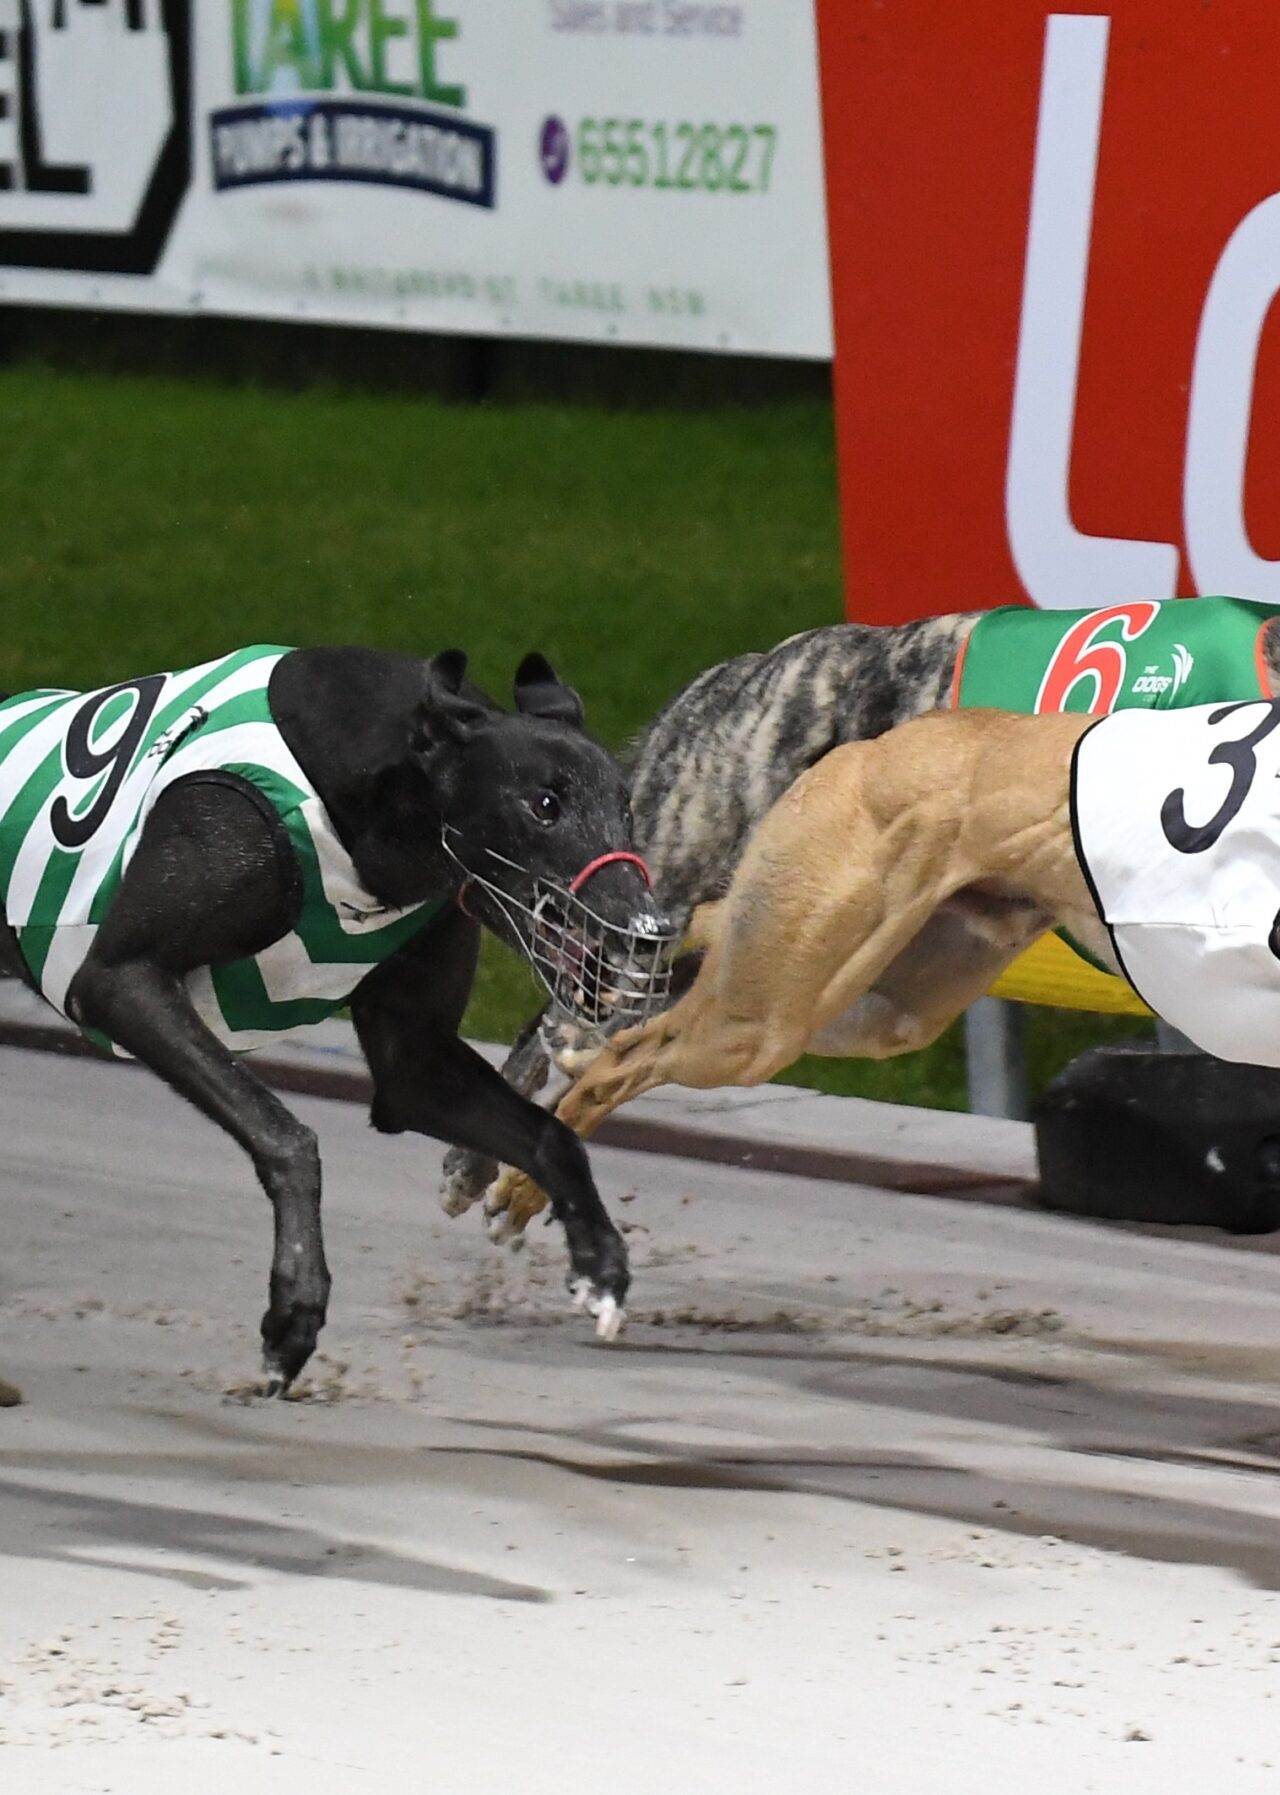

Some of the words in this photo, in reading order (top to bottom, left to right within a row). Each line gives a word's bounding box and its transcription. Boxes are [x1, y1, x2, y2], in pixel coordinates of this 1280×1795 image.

[217, 112, 305, 177] PUMPS
[308, 112, 329, 169] &
[334, 114, 484, 195] IRRIGATION
[577, 117, 777, 193] 65512827
[1034, 600, 1161, 715] 6
[1131, 676, 1173, 693] DOGS
[49, 673, 168, 848] 9
